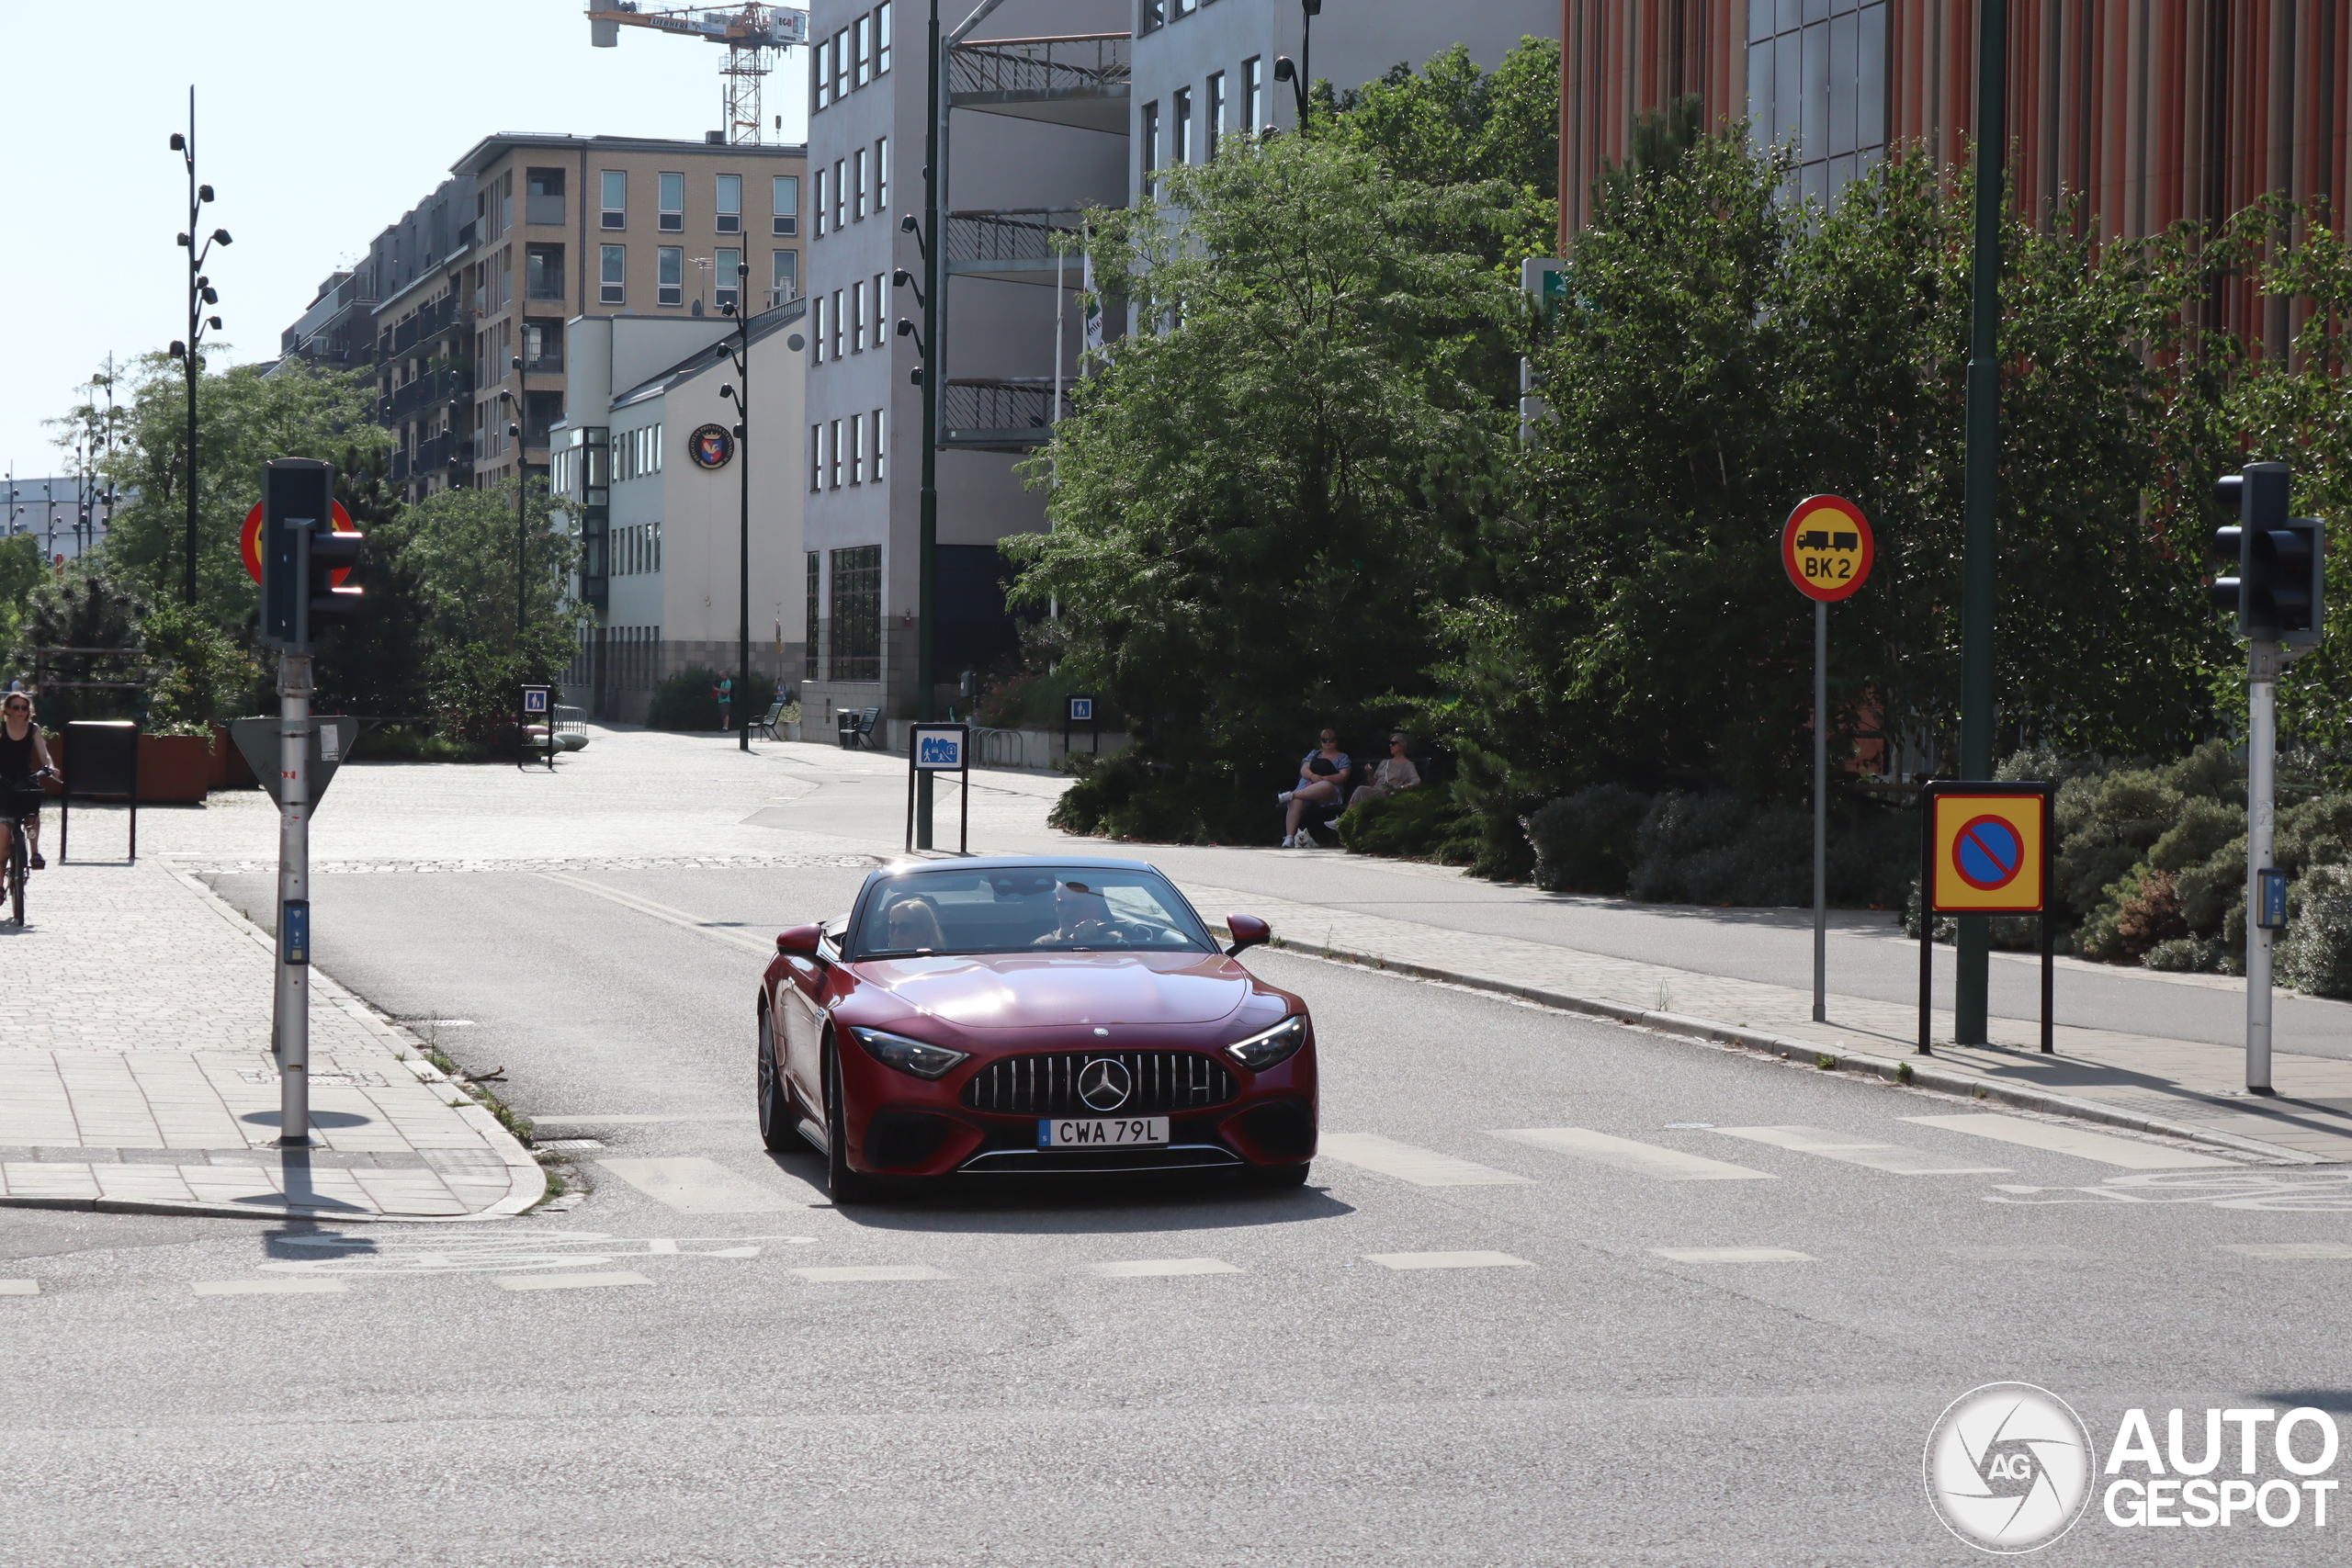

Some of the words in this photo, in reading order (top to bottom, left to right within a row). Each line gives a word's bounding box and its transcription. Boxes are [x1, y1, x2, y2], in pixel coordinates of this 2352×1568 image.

[1805, 557, 1833, 578] BK
[1838, 558, 1851, 579] 2
[1060, 1122, 1106, 1144] CWA
[1114, 1120, 1159, 1142] 79L
